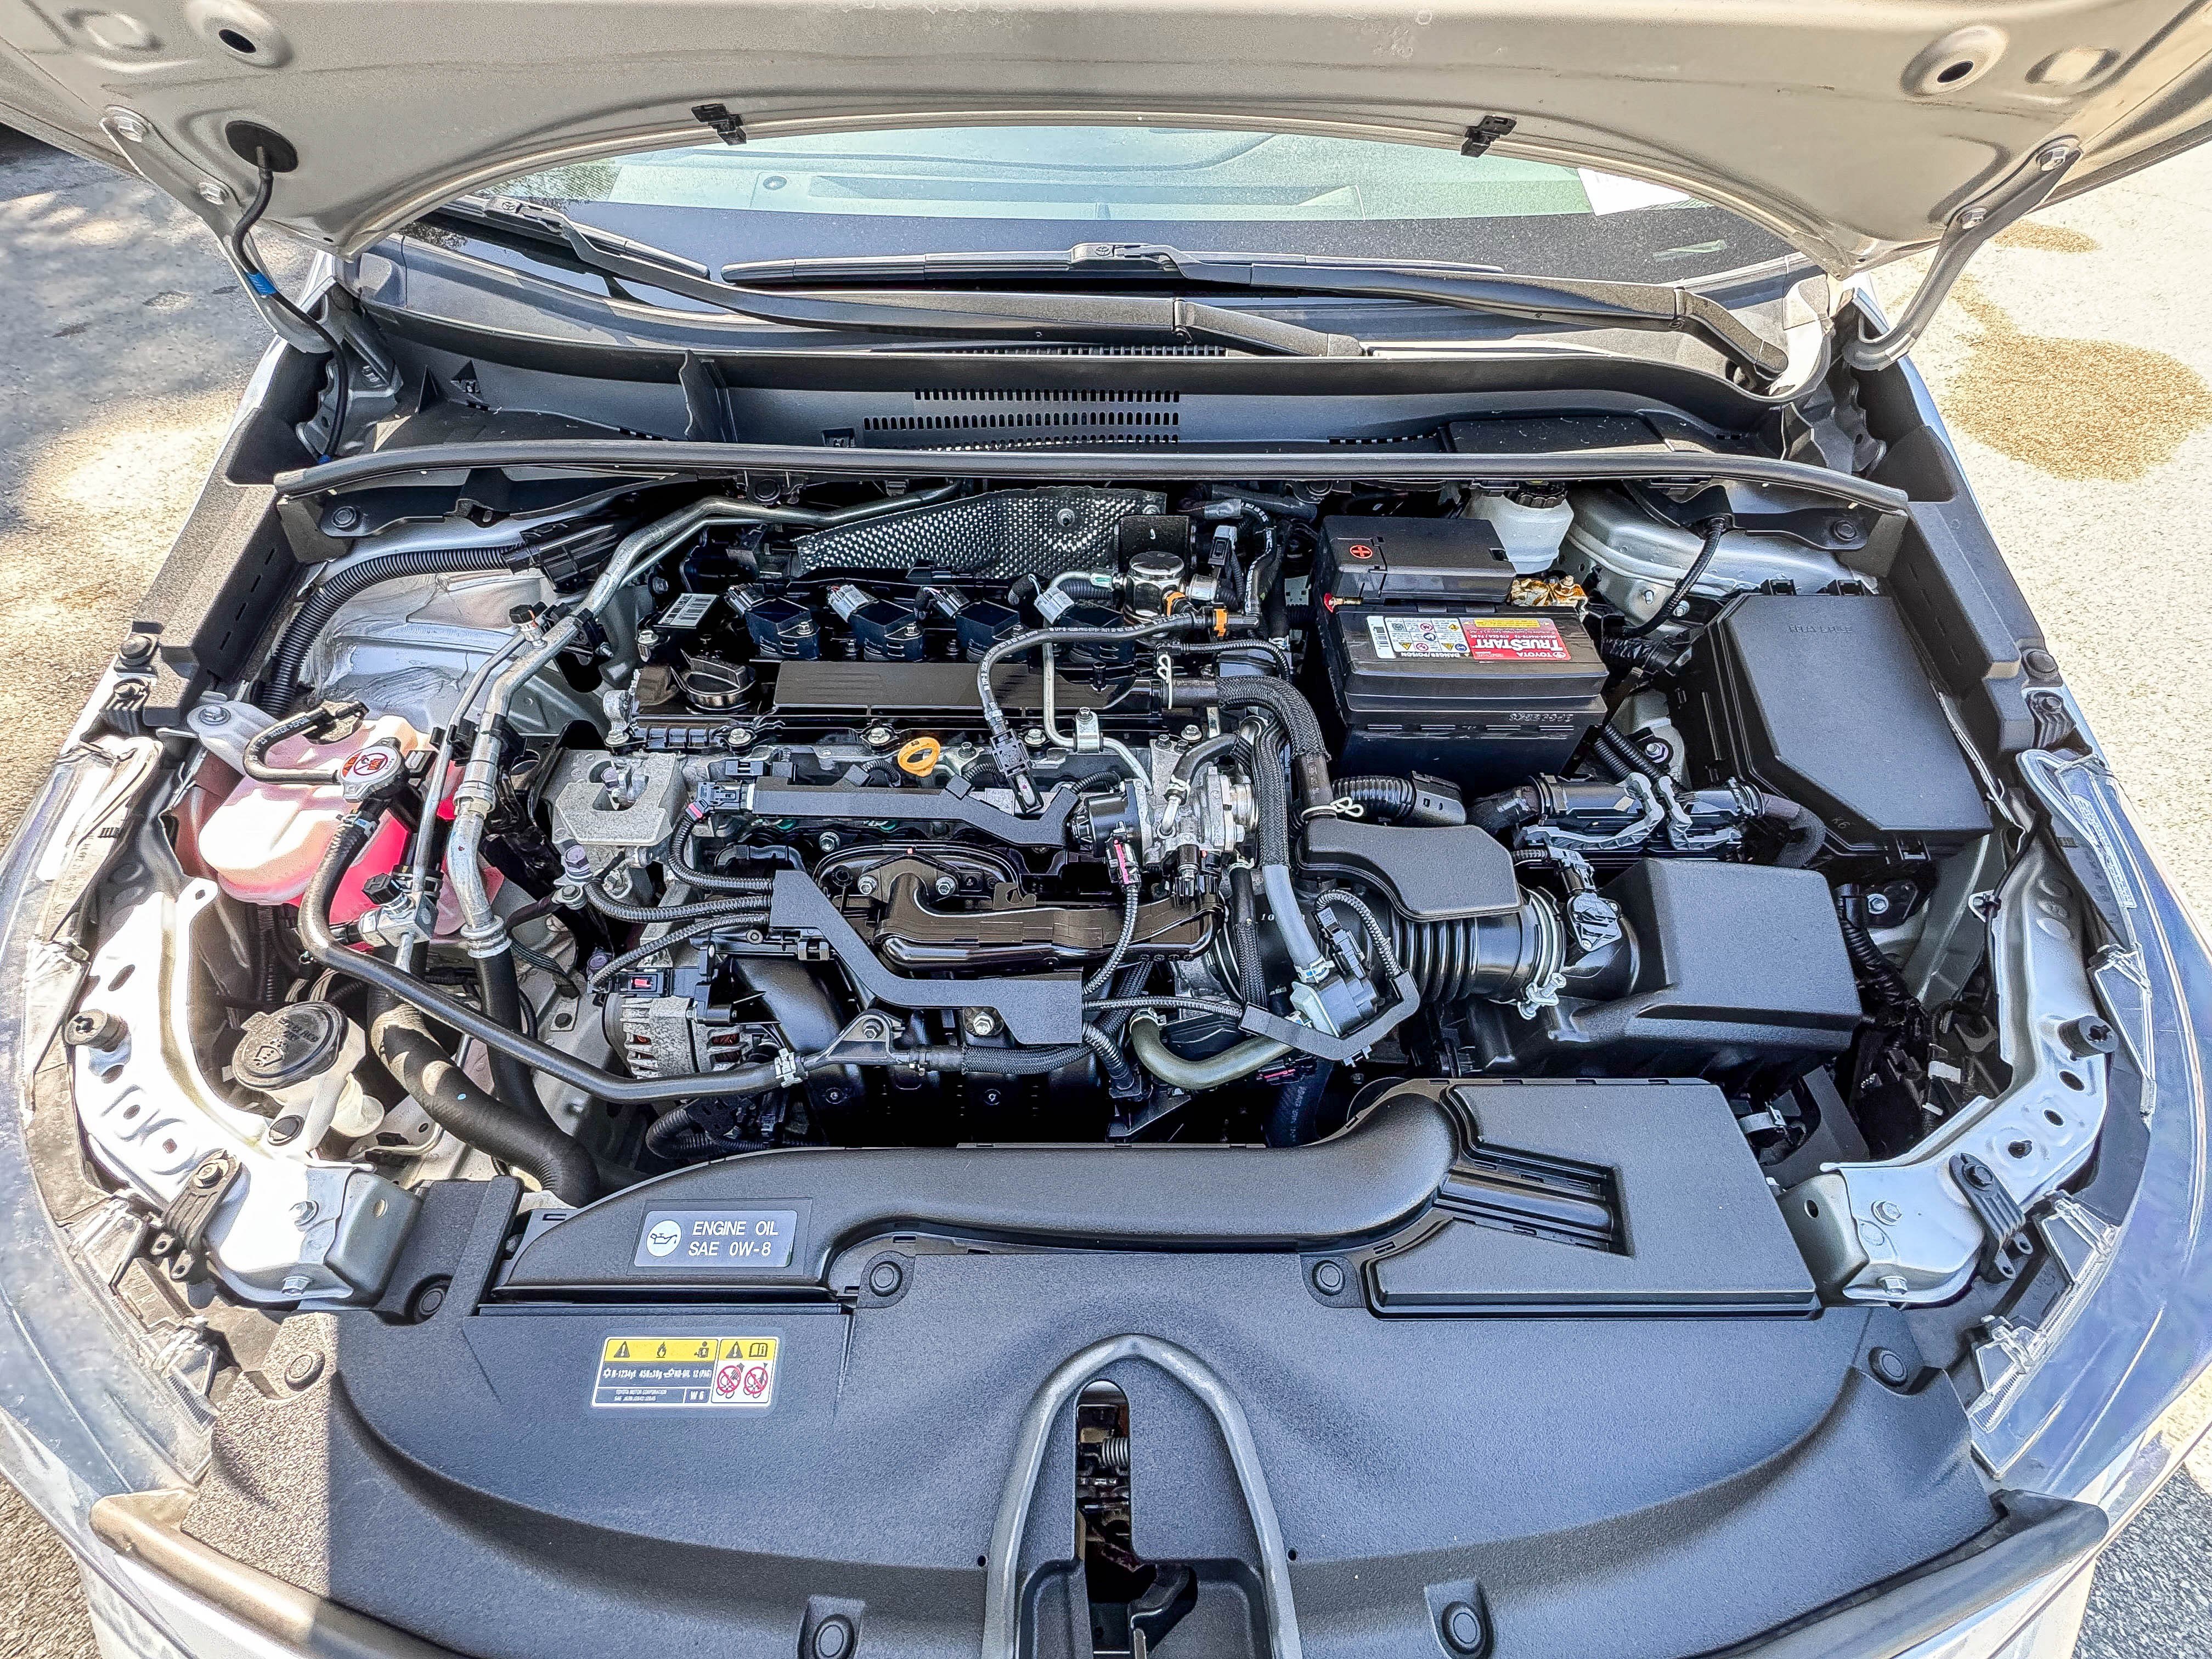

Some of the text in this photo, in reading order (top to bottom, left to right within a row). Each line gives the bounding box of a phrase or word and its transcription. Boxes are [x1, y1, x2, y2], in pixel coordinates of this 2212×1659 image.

[692, 1220, 778, 1236] ENGINE OIL
[688, 1241, 771, 1256] SAE 0W-8
[690, 1391, 698, 1400] W
